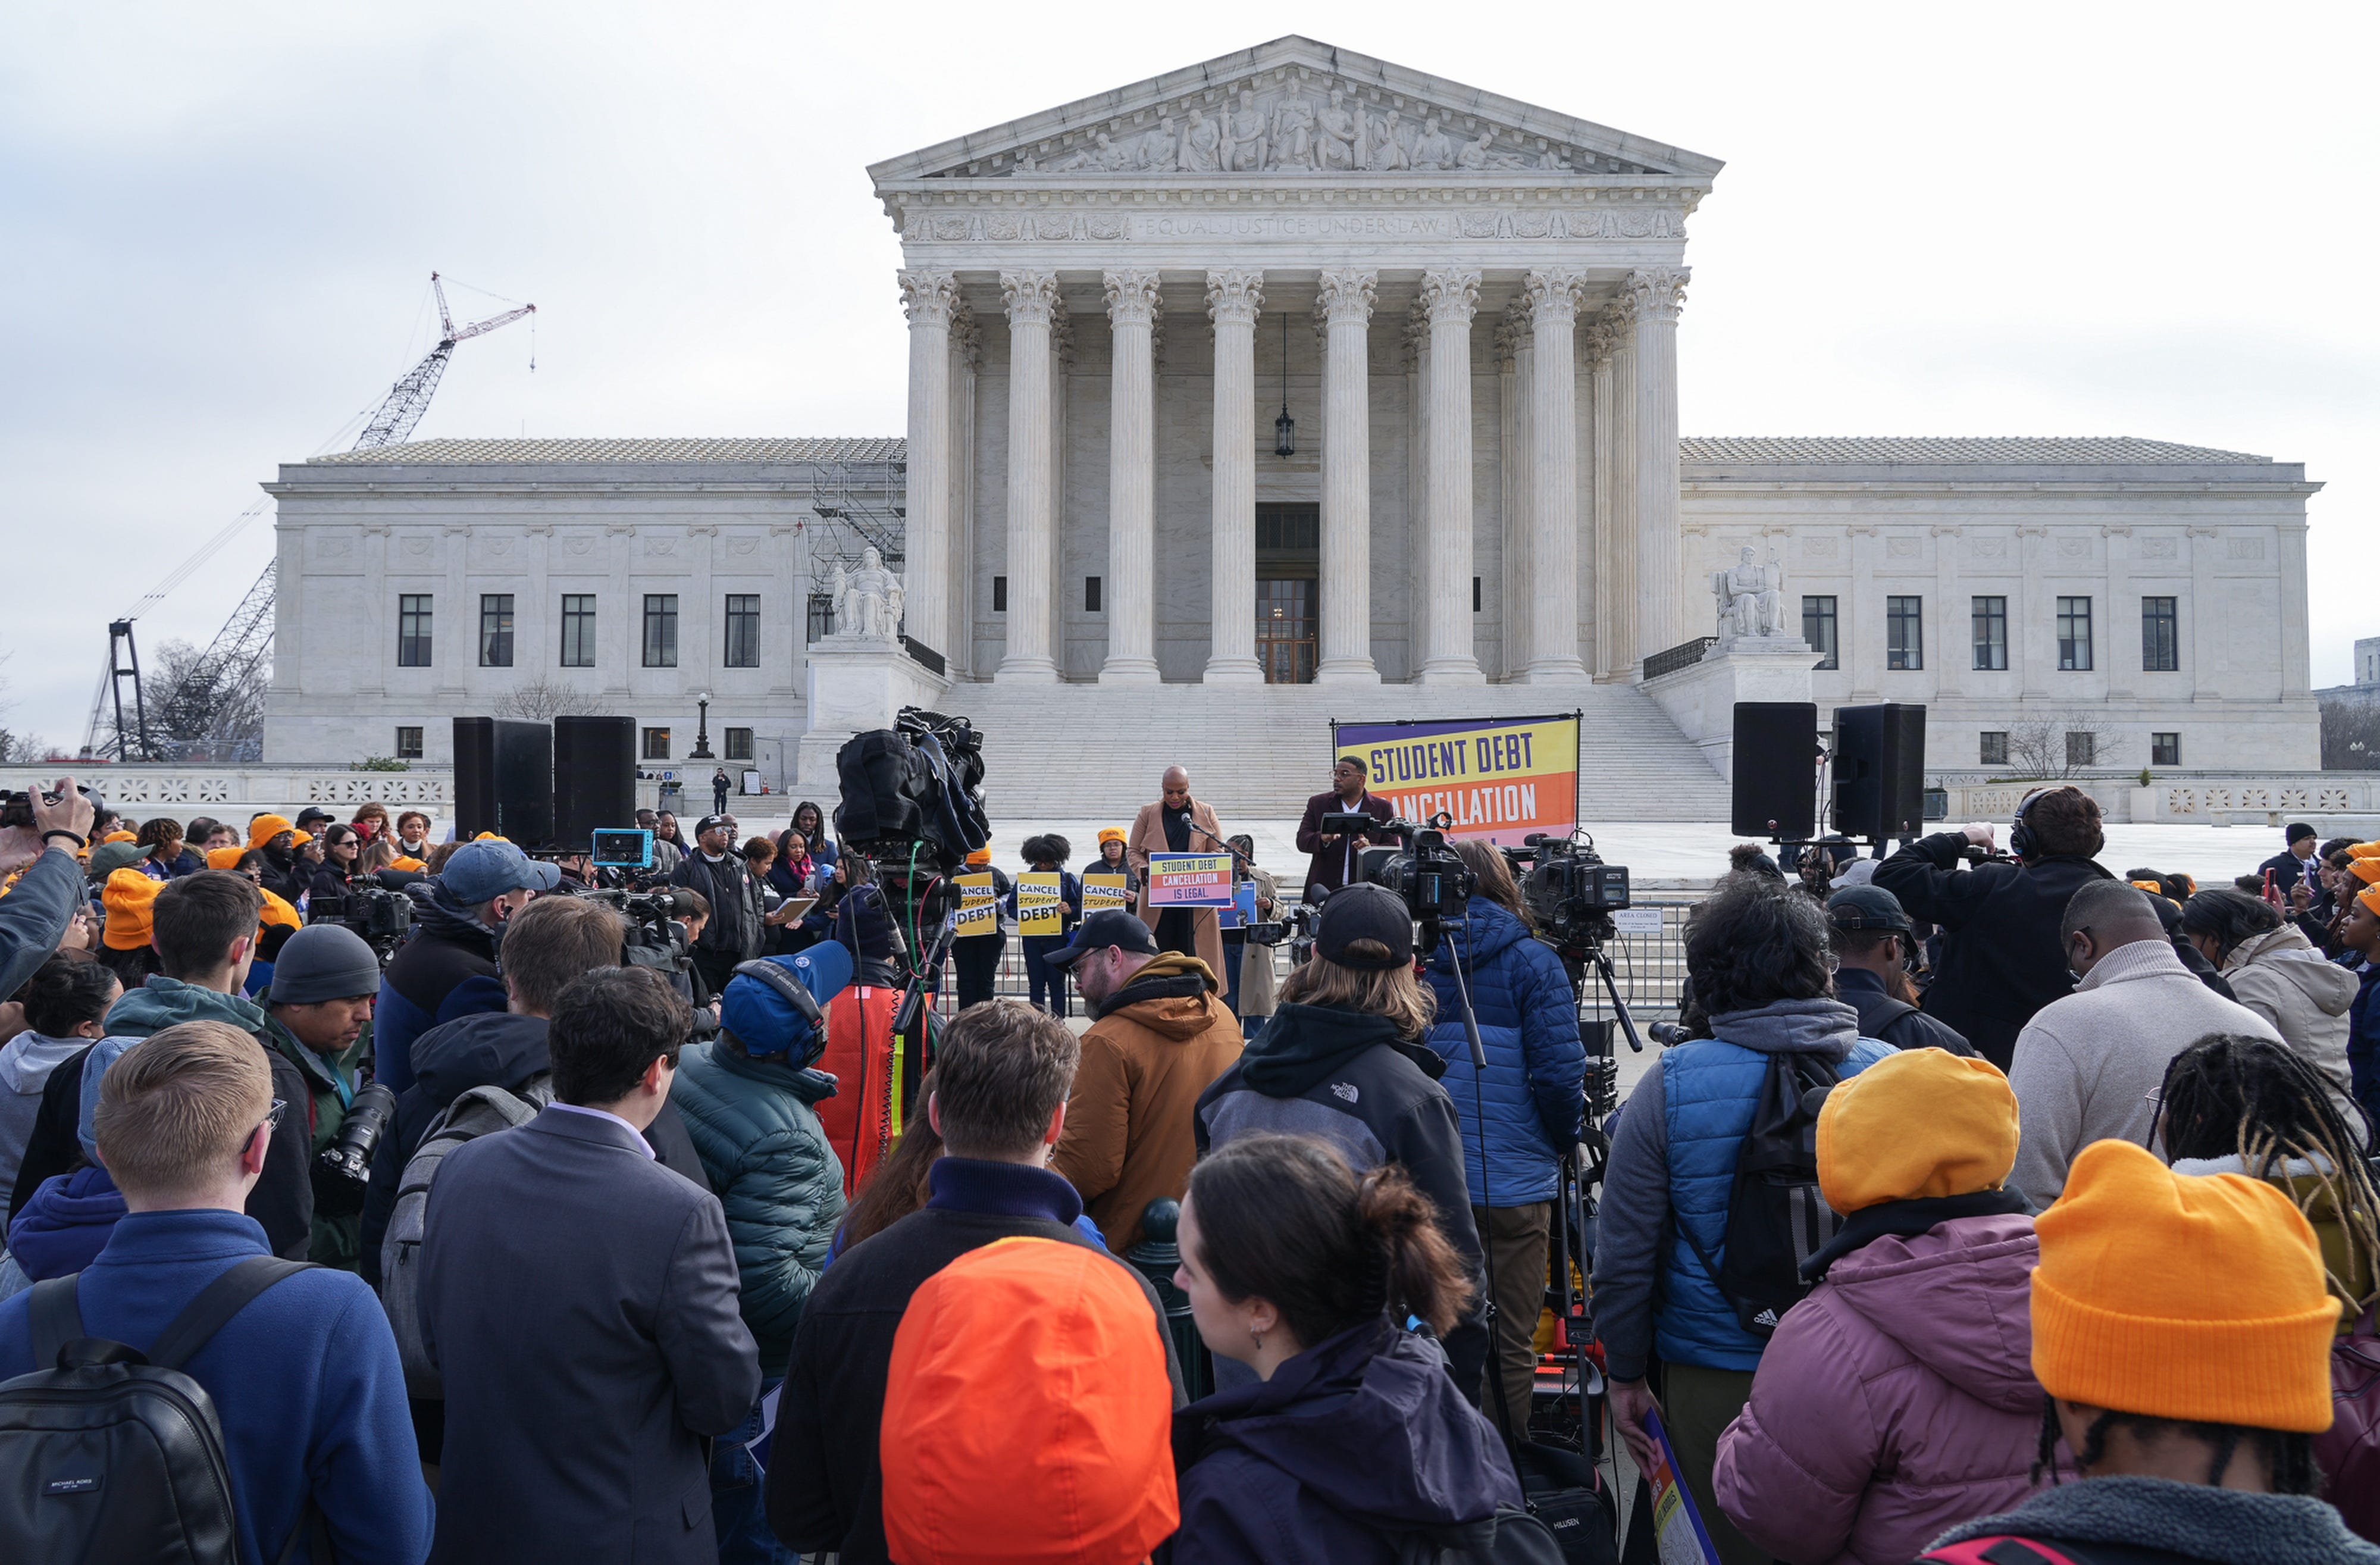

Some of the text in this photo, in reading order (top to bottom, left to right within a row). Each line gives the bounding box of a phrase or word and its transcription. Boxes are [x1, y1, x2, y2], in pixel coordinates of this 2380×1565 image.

[1145, 218, 1440, 236] EQUAL JUSTICE UNDER LAW
[1370, 732, 1533, 784] STUDENT DEBT
[1380, 783, 1537, 826] ANCELLATION
[1161, 859, 1217, 873] STUDENT DEBT
[1162, 872, 1219, 886] CANCELLATION
[962, 887, 992, 896] ANCEL
[1019, 884, 1059, 895] CANCEL
[1084, 885, 1124, 897] CANCEL
[1173, 887, 1209, 899] IS LEGAL.
[962, 897, 994, 906] TUDENT
[1019, 896, 1059, 904] STUDENT
[957, 906, 994, 925] DEBT
[1020, 906, 1057, 922] DEBT
[1330, 1083, 1351, 1096] NORTH
[1753, 1316, 1778, 1328] adida
